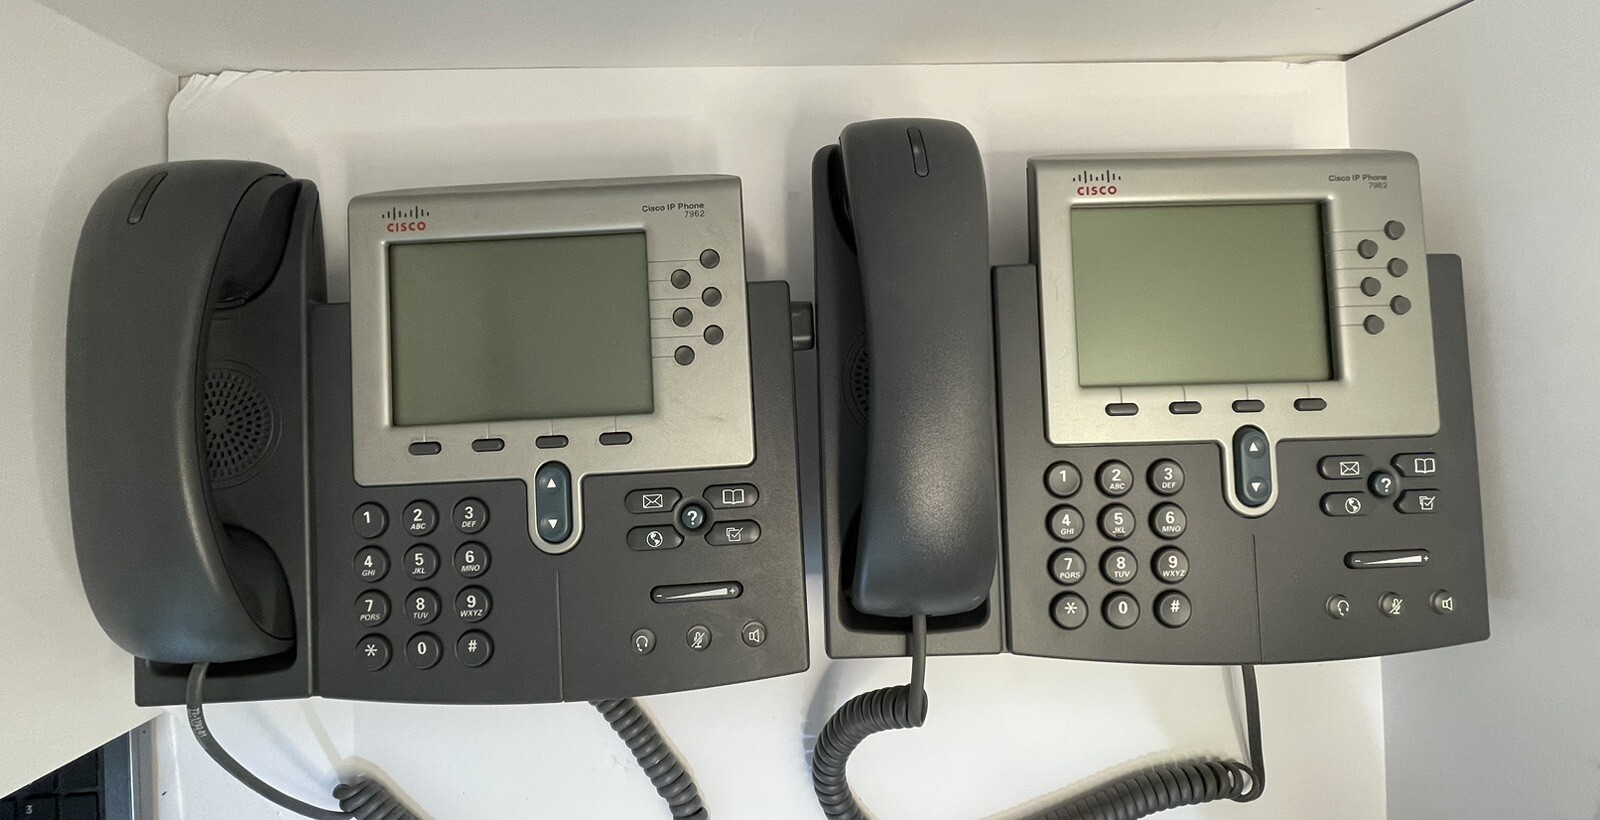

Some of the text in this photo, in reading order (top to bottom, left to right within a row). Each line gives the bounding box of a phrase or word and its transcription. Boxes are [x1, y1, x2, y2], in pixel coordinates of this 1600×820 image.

[1078, 186, 1117, 196] CISCO
[642, 205, 665, 213] Cisco
[684, 210, 705, 218] 7962
[387, 221, 426, 232] CISCO
[1060, 470, 1066, 482] 1
[1112, 469, 1122, 482] 2
[1164, 468, 1173, 481] 3
[1110, 482, 1125, 490] ABC
[363, 511, 370, 524] 1
[413, 509, 423, 522] 2
[465, 506, 474, 519] 3
[1165, 511, 1175, 524] 6
[462, 520, 477, 528] DEF
[1062, 514, 1071, 526] 4
[1114, 513, 1123, 525] 5
[410, 522, 426, 530] ABC
[364, 555, 373, 568] 4
[415, 553, 424, 566] 5
[465, 551, 474, 563] 6
[1116, 557, 1126, 569] 8
[1168, 556, 1178, 569] 9
[461, 564, 480, 572] MNO
[1064, 558, 1073, 570] 7
[365, 600, 373, 612] 7
[416, 597, 425, 611] 8
[467, 595, 476, 608] 9
[1118, 601, 1128, 614] 0
[460, 609, 483, 617] WXYZ
[417, 642, 427, 655] 0
[25, 805, 33, 814] 3
